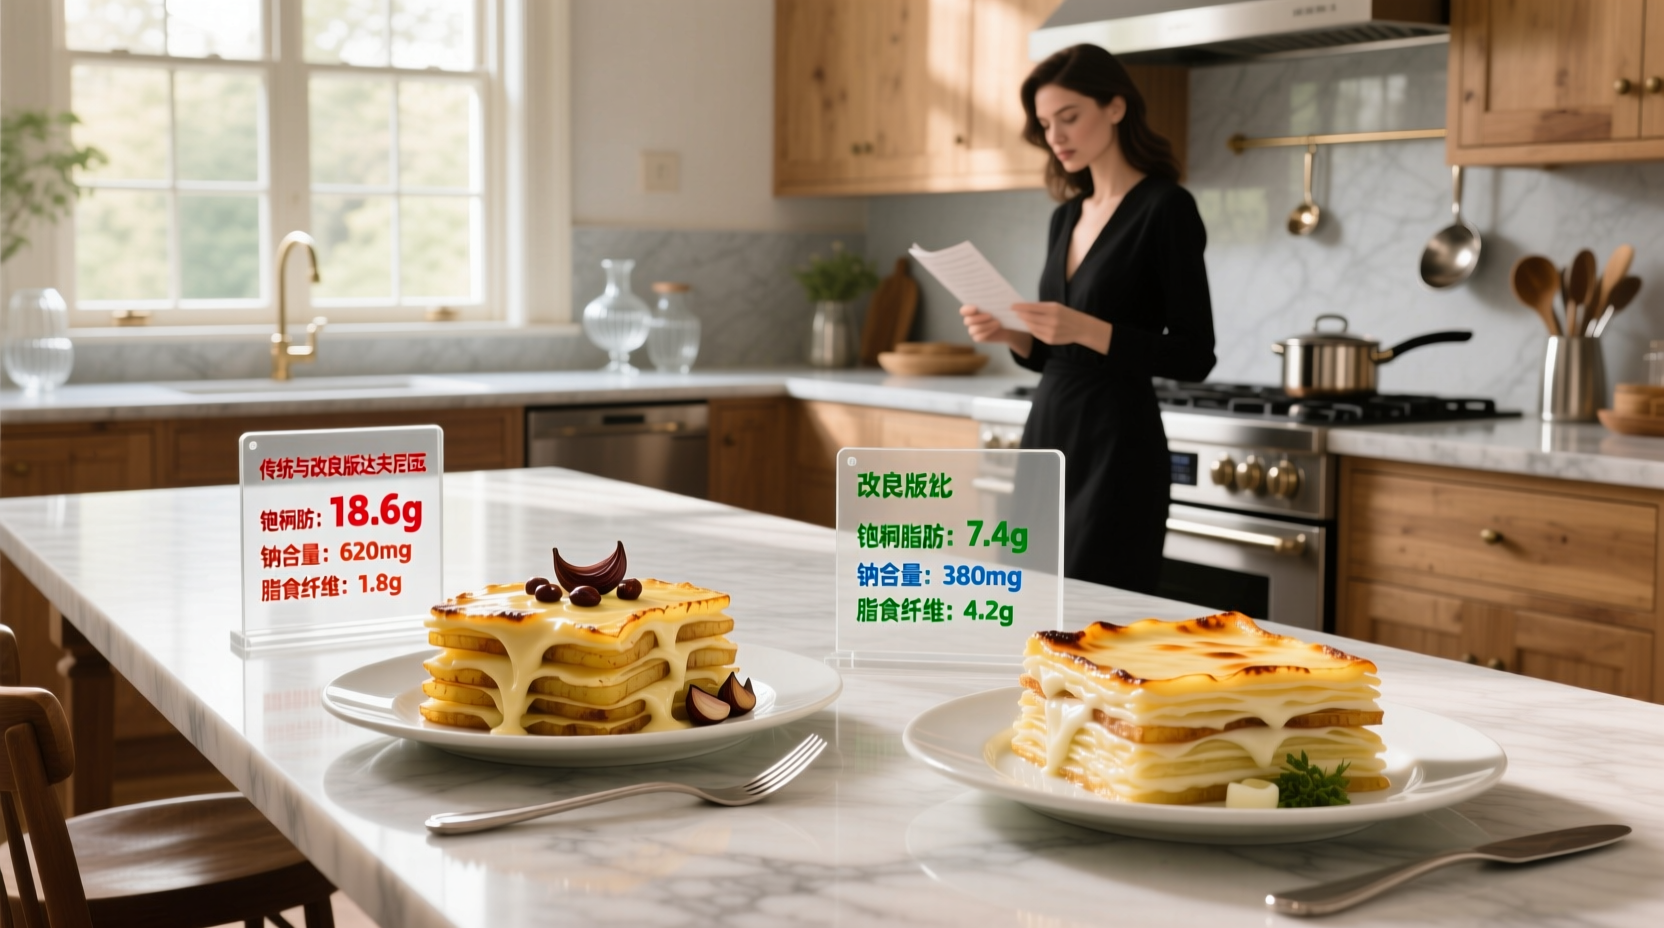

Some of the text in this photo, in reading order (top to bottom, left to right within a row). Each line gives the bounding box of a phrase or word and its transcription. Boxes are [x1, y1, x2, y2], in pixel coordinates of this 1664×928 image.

[330, 493, 423, 532] 18.6g
[967, 520, 1028, 554] 7.4g
[340, 541, 412, 563] 620mg
[359, 573, 402, 597] 1.8g
[943, 565, 1022, 593] 380mg
[963, 600, 1014, 627] 4.2g
